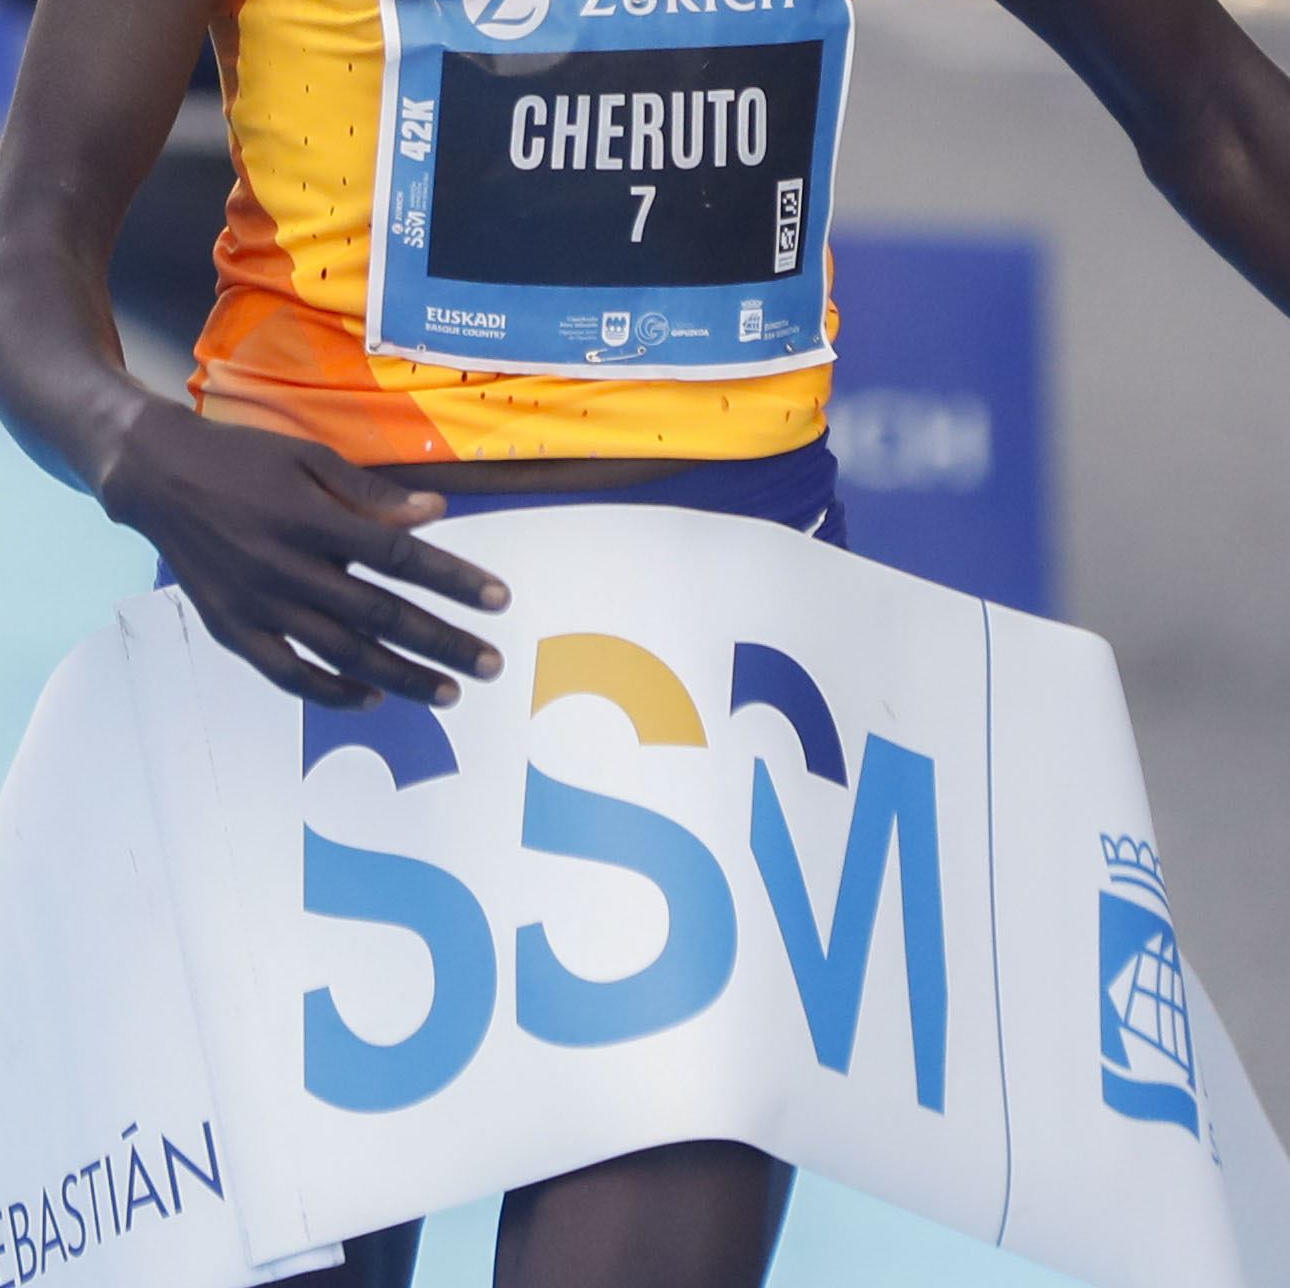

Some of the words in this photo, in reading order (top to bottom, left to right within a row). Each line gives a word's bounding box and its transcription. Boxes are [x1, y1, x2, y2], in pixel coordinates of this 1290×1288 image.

[400, 96, 435, 162] 42K
[509, 87, 768, 171] CHERUTO
[629, 186, 657, 243] 7
[425, 323, 460, 336] BASQUE
[462, 327, 506, 340] COUNTRY
[426, 306, 506, 329] EUSKADI
[303, 633, 948, 1115] SSM
